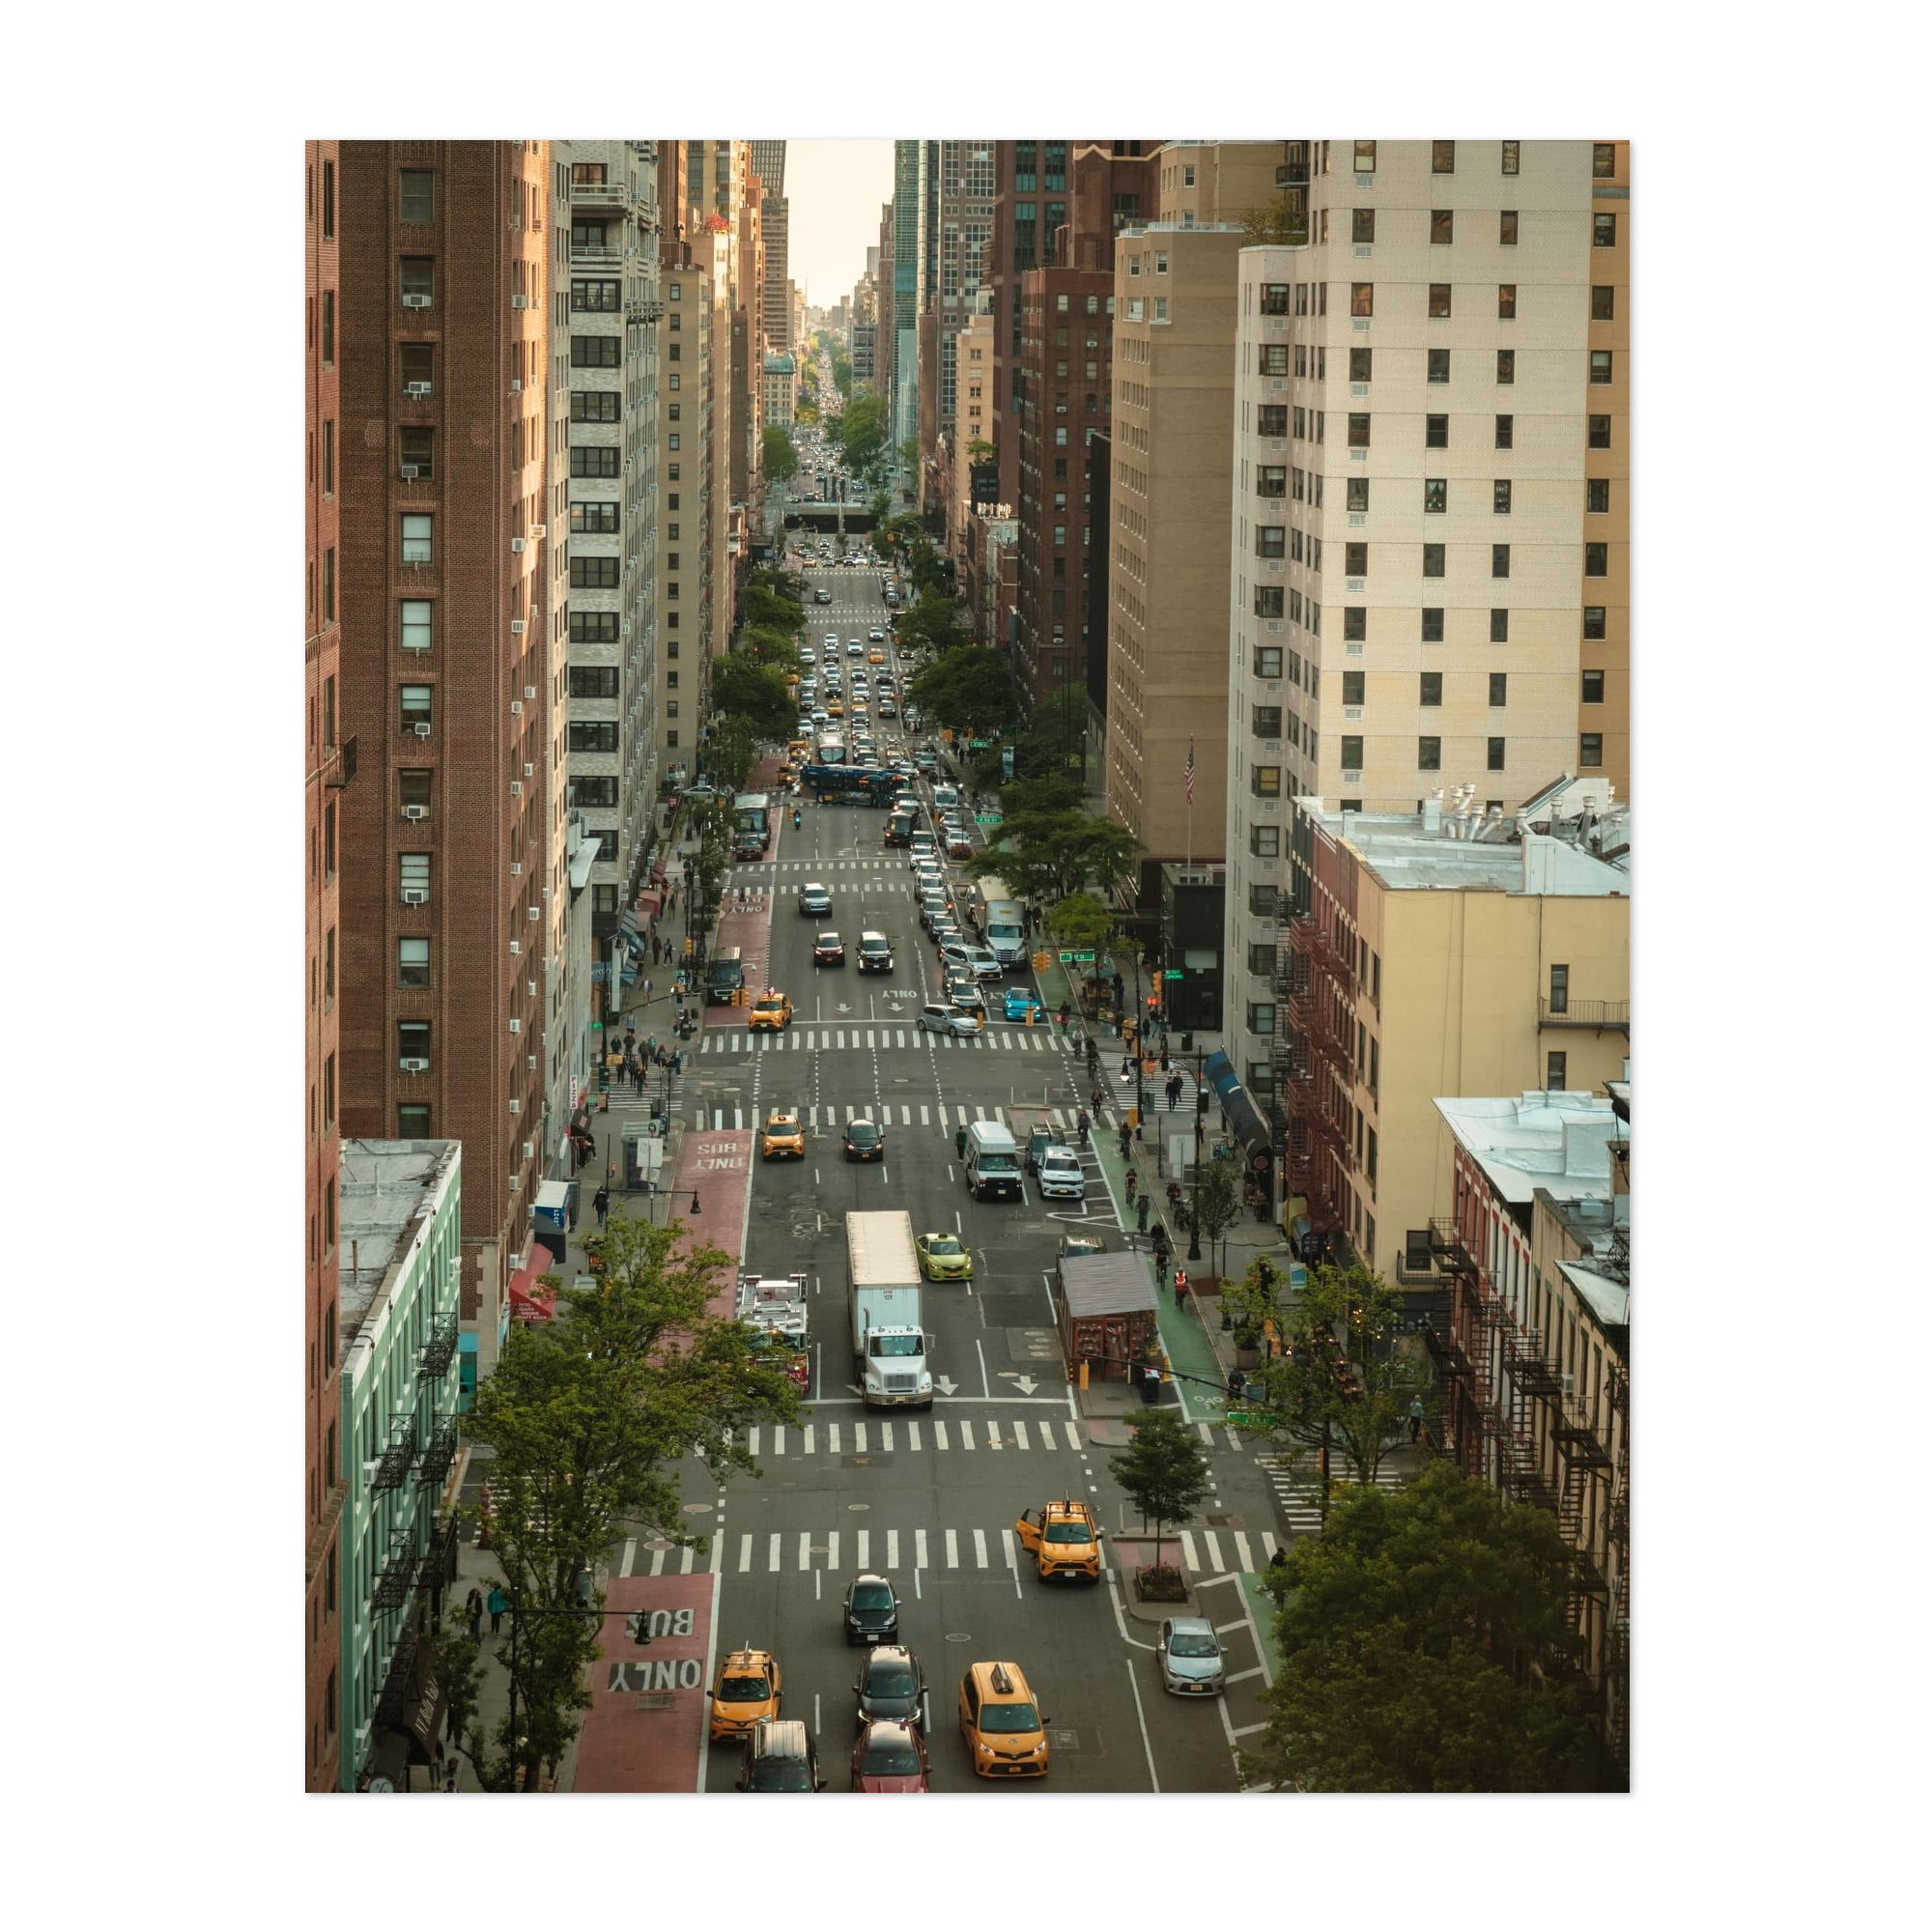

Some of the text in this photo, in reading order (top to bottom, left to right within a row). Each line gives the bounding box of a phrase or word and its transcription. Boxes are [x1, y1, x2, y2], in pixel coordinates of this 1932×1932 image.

[882, 989, 918, 998] ONLY
[697, 1143, 737, 1154] BUS
[690, 1157, 743, 1170] ONLY
[608, 1659, 702, 1692] ONLY
